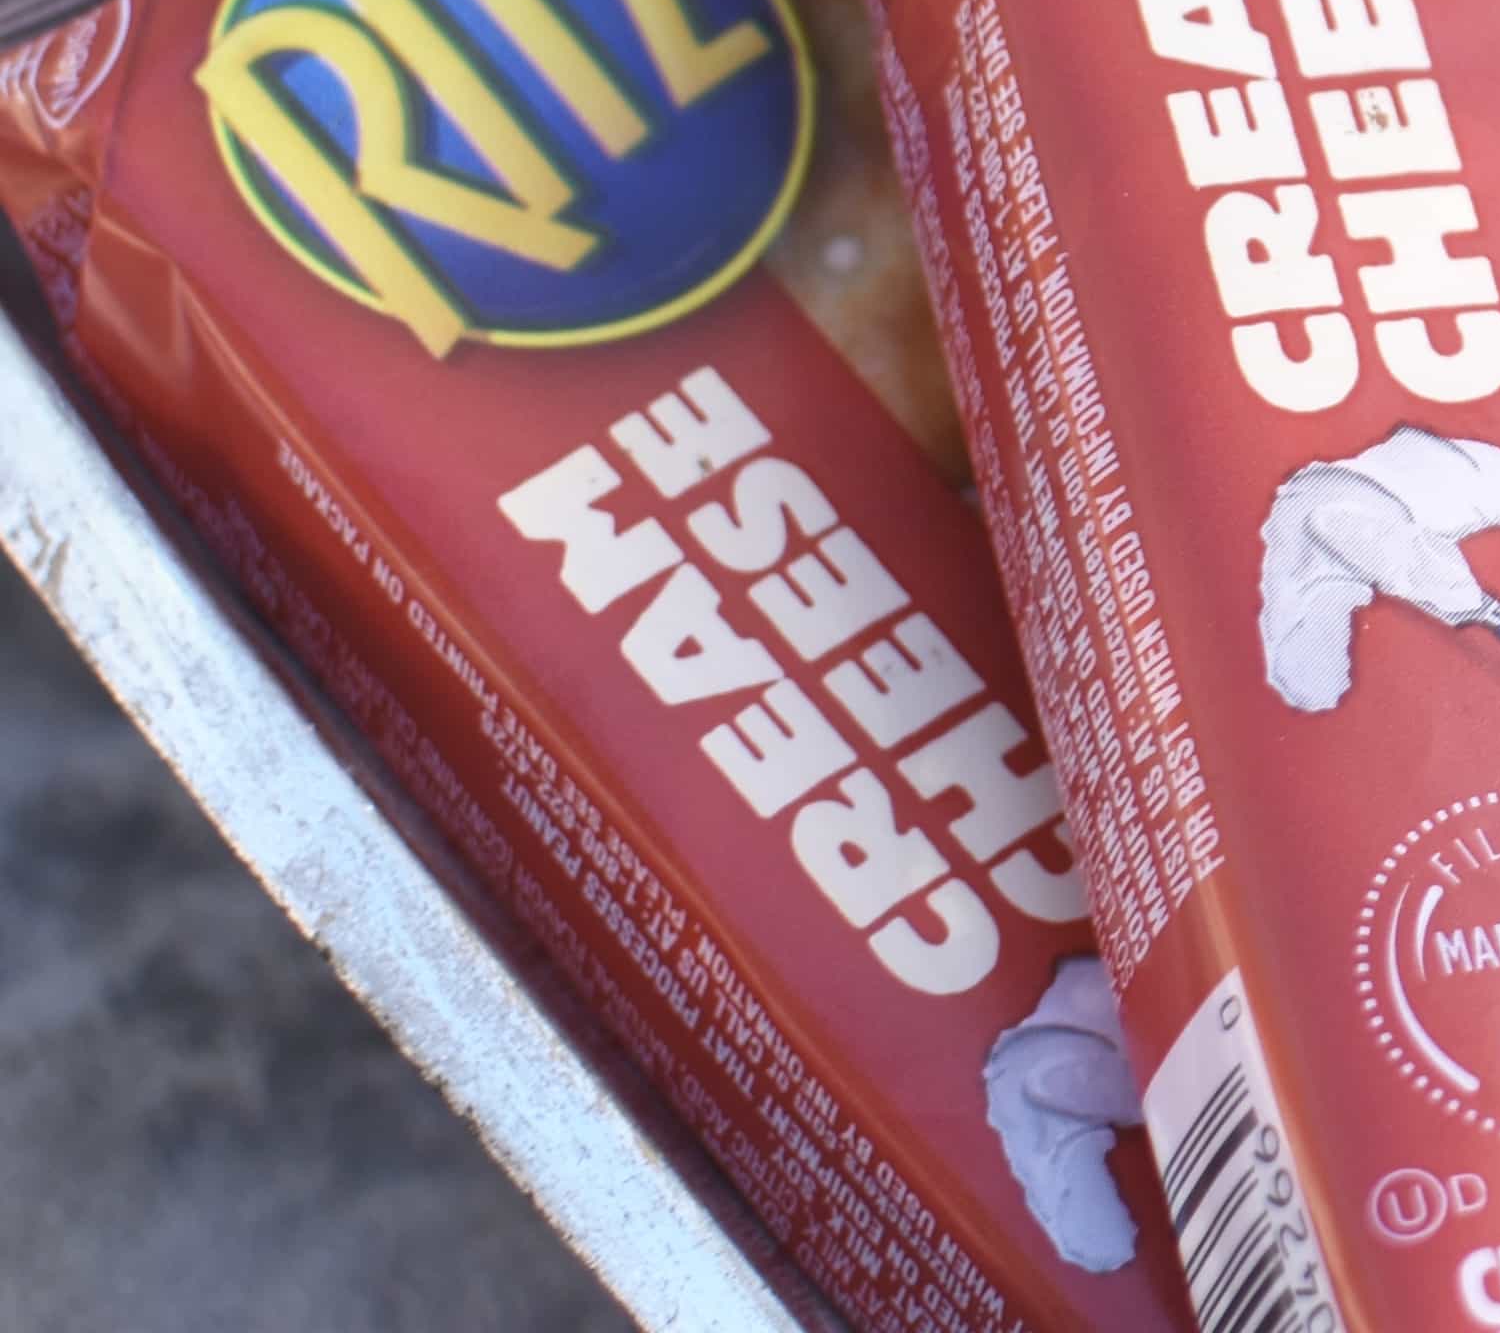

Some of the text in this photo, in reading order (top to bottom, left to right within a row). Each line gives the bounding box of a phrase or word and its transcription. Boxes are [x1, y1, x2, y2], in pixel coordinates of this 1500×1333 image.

[986, 72, 1030, 144] SEE
[1002, 135, 1059, 259] PLEASE
[961, 187, 1018, 371] PROCESSES
[996, 224, 1029, 283] AT:
[1007, 278, 1042, 334] US
[1001, 367, 1038, 454] THAT
[1020, 324, 1062, 414] CALL
[1034, 249, 1123, 486] INFORMATION,
[1044, 410, 1073, 450] or
[1022, 447, 1084, 631] EQUIPMENT
[1092, 483, 1134, 535] BY
[1037, 571, 1071, 670] MILK,
[1053, 445, 1141, 712] Ritzcrackers.com
[1105, 529, 1157, 625] USED
[610, 365, 1095, 924] CHEESE
[1069, 625, 1098, 680] ON
[1129, 616, 1184, 725] WHEN
[498, 444, 1001, 996] CREAM
[1061, 663, 1104, 792] WHEAT,
[1121, 704, 1157, 766] AT:
[1157, 719, 1208, 811] BEST
[1083, 677, 1170, 939] MANUFACTURED
[1138, 763, 1170, 820] US
[272, 437, 1004, 1323] WHEN USED BY INFORMATION, PLEASE SEE DATE PRINTED ON PACKAGE
[1094, 790, 1150, 961] CONTAINS:
[1153, 817, 1193, 910] VISIT
[1178, 801, 1227, 883] FOR
[578, 870, 703, 1031] PROCESSES
[635, 899, 680, 953] AT:
[673, 946, 713, 998] US
[697, 1023, 755, 1099] THAT
[711, 987, 766, 1065] CALL
[758, 1093, 885, 1245] EQUIPMENT
[824, 1194, 884, 1280] MILK,
[881, 1236, 921, 1288] ON
